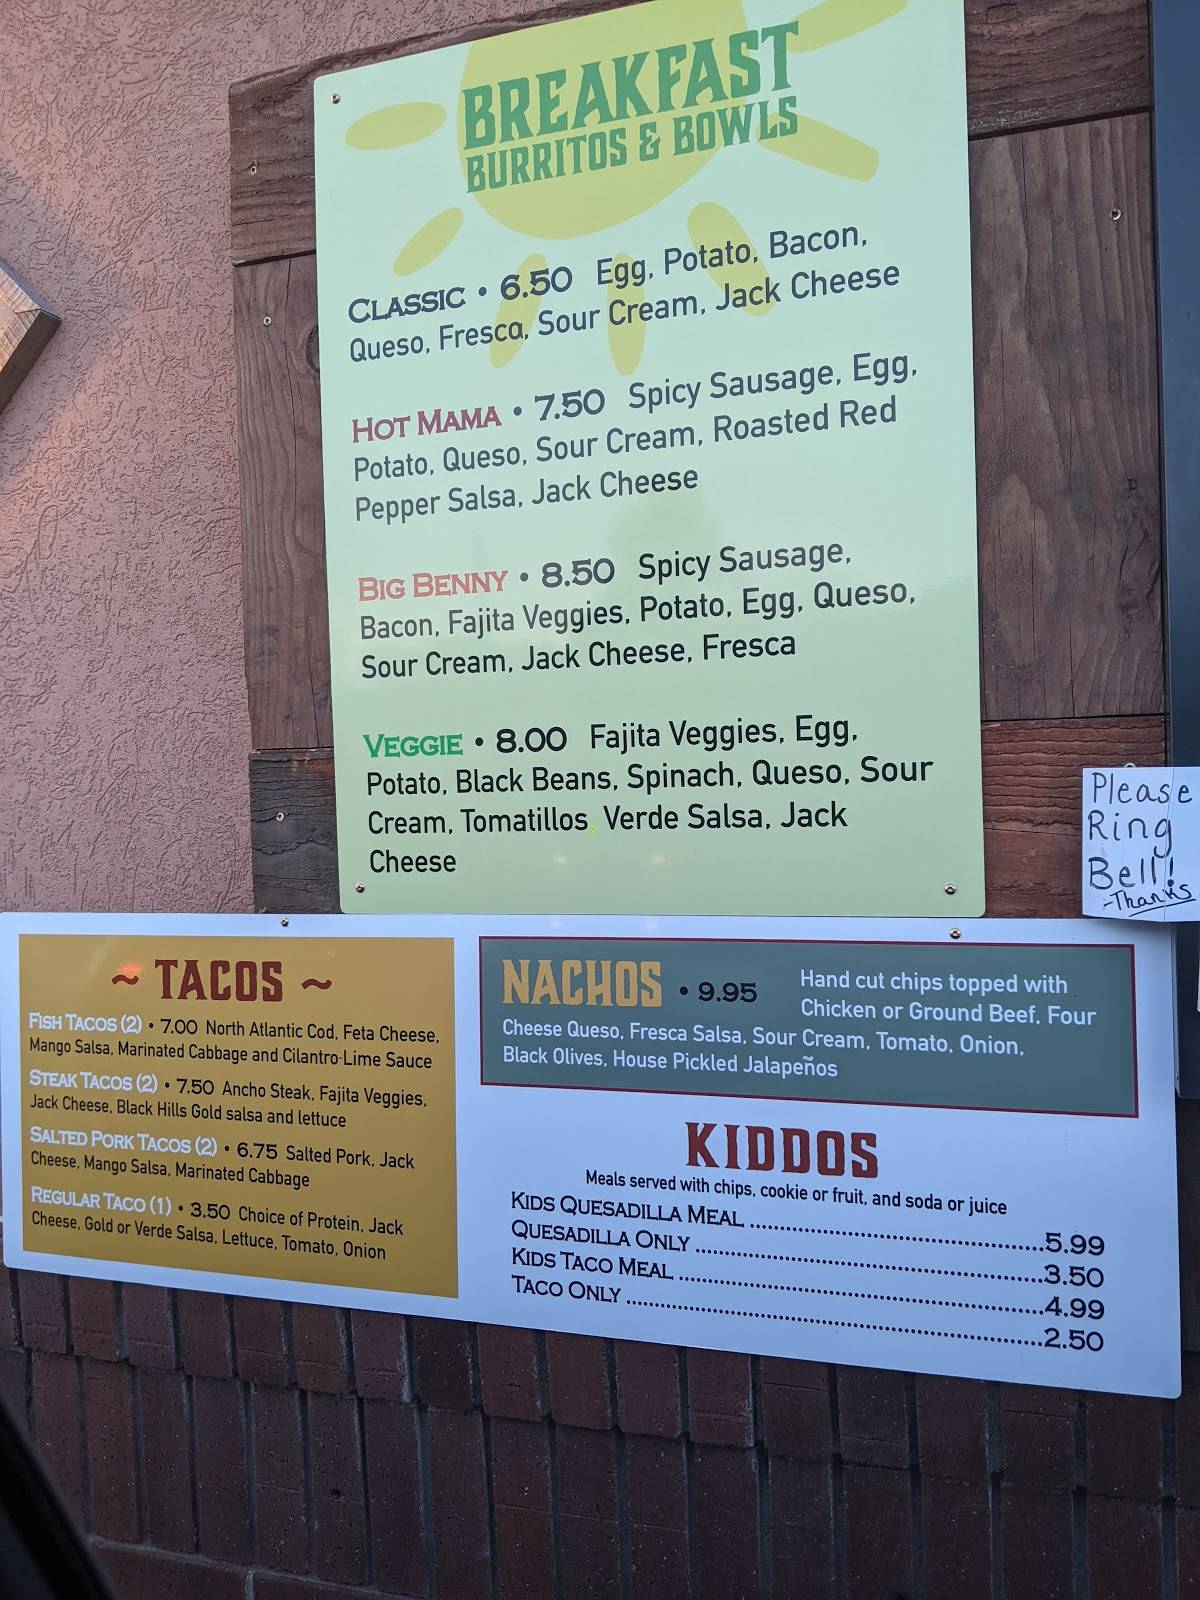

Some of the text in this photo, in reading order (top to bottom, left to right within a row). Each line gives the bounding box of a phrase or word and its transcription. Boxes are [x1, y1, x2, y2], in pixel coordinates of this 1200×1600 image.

[461, 21, 800, 152] BREAKFAST
[465, 95, 800, 195] BURRITOS & BOWLS
[500, 265, 573, 301] 6.50
[596, 257, 654, 290] Egg,
[664, 240, 759, 276] Potato,
[769, 226, 867, 259] Bacon,
[349, 265, 900, 363] Queso, Fresca, Sour Cream, Jack Cheese
[534, 388, 606, 422] 7.50
[628, 377, 702, 415] Spicy
[709, 364, 842, 399] Sausage,
[853, 351, 917, 387] Egg,
[354, 394, 897, 482] Potato, Queso, Sour Cream, Roasted Red
[541, 557, 616, 589] 8.50
[638, 550, 712, 586] Spicy
[718, 543, 852, 573] Sausage,
[360, 581, 915, 640] Bacon, Fajita Veggies, Potato, Egg, Queso,
[495, 726, 568, 754] 8.00
[590, 721, 661, 756] Fajita
[668, 717, 785, 753] Veggies,
[795, 714, 858, 749] Egg,
[366, 755, 935, 796] Potato, Black Beans, Spinach, Queso, Sour
[1091, 772, 1193, 805] Please
[1087, 808, 1173, 859] Ring
[369, 848, 457, 874] Cheese
[1087, 855, 1175, 891] Bell!
[154, 958, 284, 1003] TACOS
[501, 958, 758, 1009] NACHOS 9.95
[800, 968, 1069, 997] Hand cut chips topped with
[64, 1013, 118, 1033] TACOS
[120, 1013, 143, 1035] (2)
[160, 1017, 199, 1035] 7.00
[206, 1019, 245, 1037] North
[248, 1020, 304, 1039] Atlantic
[307, 1022, 339, 1041] Cod,
[343, 1023, 375, 1041] Feta
[379, 1024, 440, 1045] Cheese,
[801, 997, 1098, 1026] Chicken or Ground Beef, Four
[29, 1036, 433, 1069] Mango Salsa, Marinated Cabbage and Cilantro-Lime Sauce
[502, 1018, 1025, 1057] Cheese Queso, Fresca Salsa, Sour Cream, Tomato, Onion,
[503, 1045, 839, 1080] Black Olives, House Pickled Jalapeños
[29, 1093, 347, 1128] Jack Cheese, Black Hills Gold salsa and lettuce
[176, 1077, 427, 1110] 7.50 Ancho Steak, Fajita Veggies,
[236, 1141, 415, 1170] 6.75 Salted Pork, Jack
[684, 1121, 879, 1179] KIDDOS
[30, 1150, 310, 1191] Cheese, Mango Salsa, Marinated Cabbage
[585, 1168, 1008, 1217] Meals served with chips, cookie or fruit, and soda or juice
[31, 1210, 386, 1261] Cheese, Gold or Verde Salsa, Lettuce, Tomato, Onion
[189, 1201, 404, 1236] 3.50 Choice of Protein, Jack
[1044, 1231, 1106, 1257] 5.99
[1043, 1263, 1105, 1289] 3.50
[1044, 1295, 1105, 1321] 4.99
[1043, 1326, 1105, 1353] 2.50
